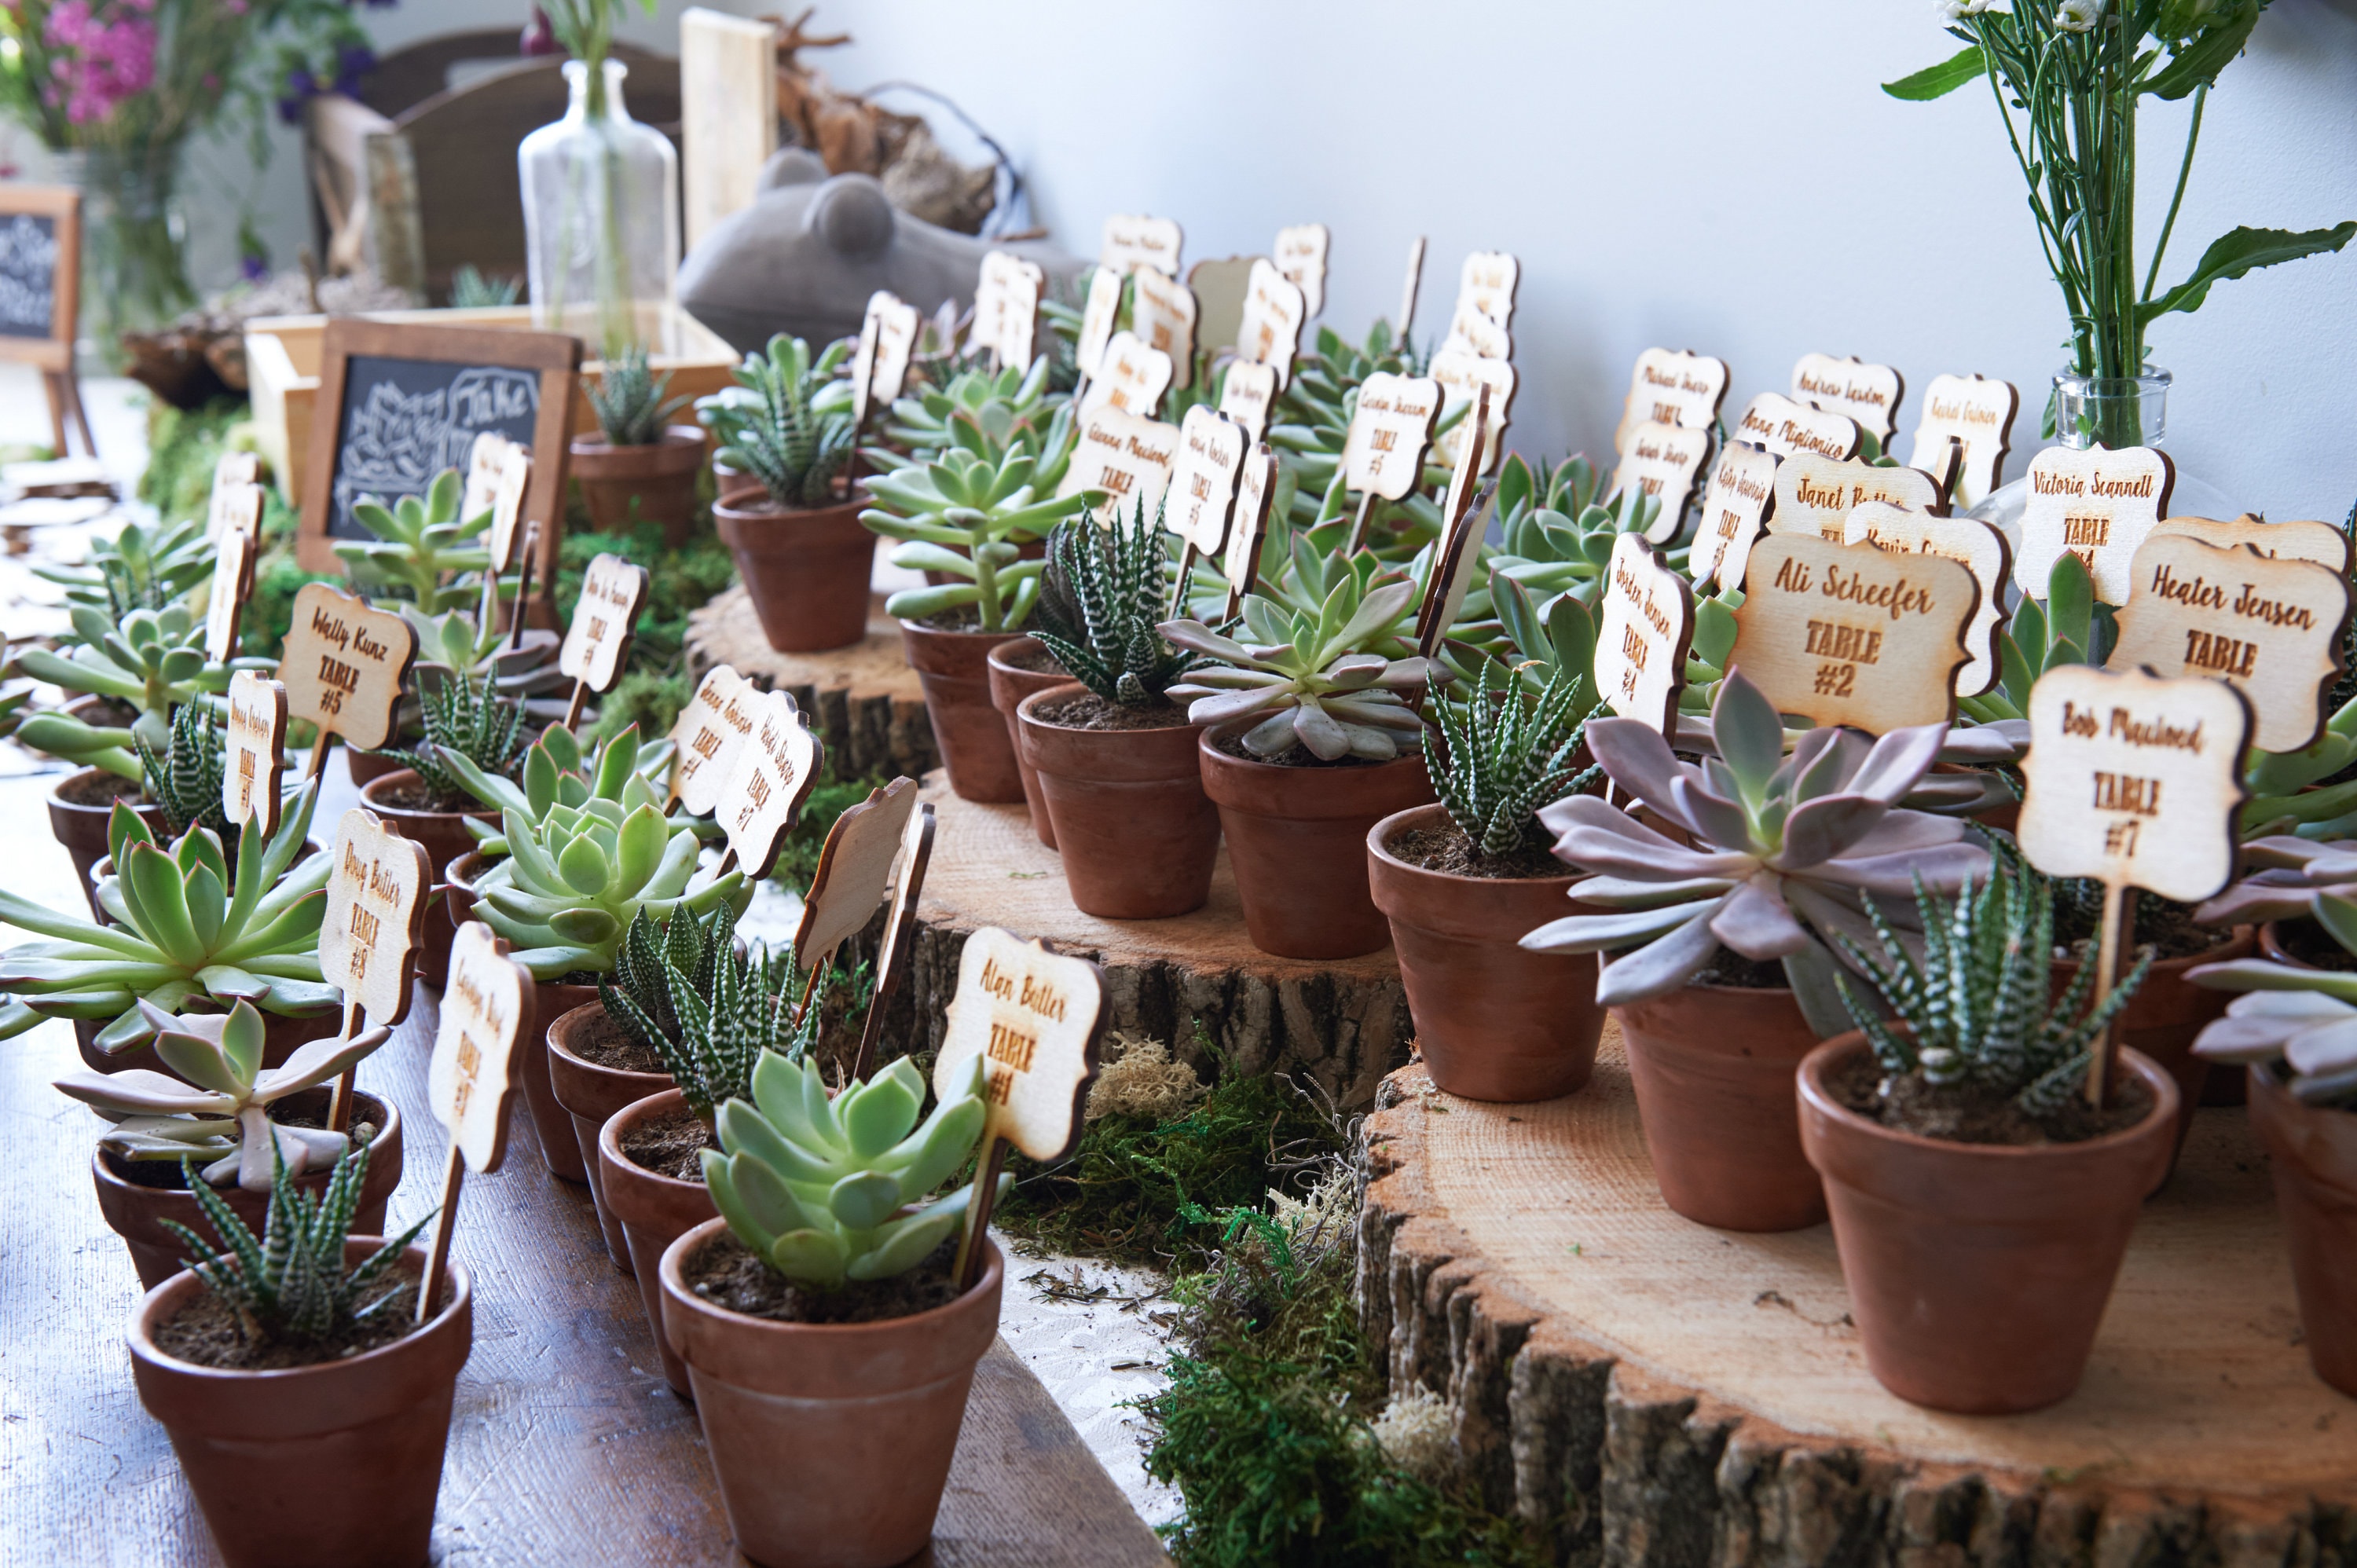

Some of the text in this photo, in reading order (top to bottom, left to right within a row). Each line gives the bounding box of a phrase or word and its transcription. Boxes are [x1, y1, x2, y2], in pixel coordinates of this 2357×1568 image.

[1741, 407, 1775, 438] Anna
[1099, 466, 1135, 494] TABLE
[1797, 478, 1845, 511] Janet
[2034, 471, 2154, 499] Victoria Scannell
[1717, 509, 1741, 542] TABLE
[2064, 518, 2110, 546] TABLE
[1775, 557, 1936, 621] Ali Scheefer
[2151, 564, 2317, 632] Heater Jensen
[312, 606, 388, 661] Wally Kunz
[1622, 623, 1648, 673] TABLE
[1805, 620, 1883, 665] TABLE
[2184, 629, 2258, 679] TABLE
[318, 654, 360, 694] TABLE
[1622, 668, 1637, 702] #4
[1814, 664, 1857, 698] #2
[320, 689, 343, 716] #5
[2062, 701, 2099, 738] Bob
[692, 726, 722, 760] TABLE
[240, 747, 256, 782] TABLE
[746, 767, 771, 811] TABLE
[2094, 771, 2161, 816] TABLE
[2105, 820, 2139, 857] #7
[343, 838, 401, 909] Doug Butler
[350, 902, 380, 949] TABLE
[350, 946, 368, 980] #8
[981, 958, 1067, 1023] Alan Butler
[988, 1024, 1037, 1074] TABLE
[989, 1071, 1014, 1106] #1
